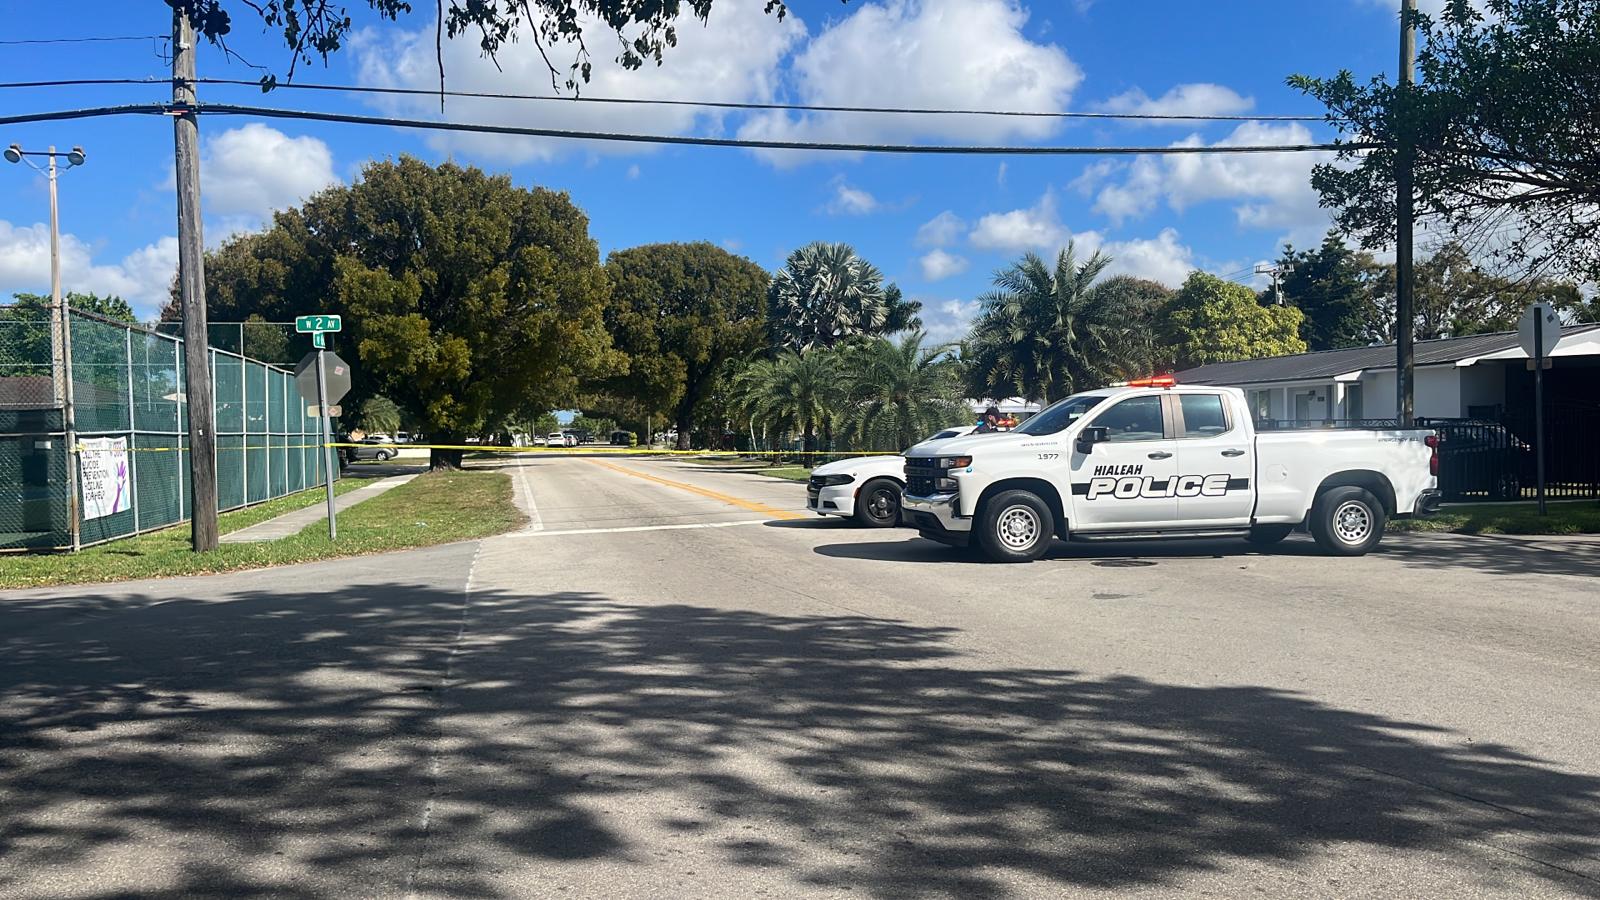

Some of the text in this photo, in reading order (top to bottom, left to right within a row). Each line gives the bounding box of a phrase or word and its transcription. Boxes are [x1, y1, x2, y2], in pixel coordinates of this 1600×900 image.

[306, 318, 336, 330] W 2 AV
[1094, 464, 1143, 476] HIALEAH
[1086, 474, 1231, 500] POLICE
